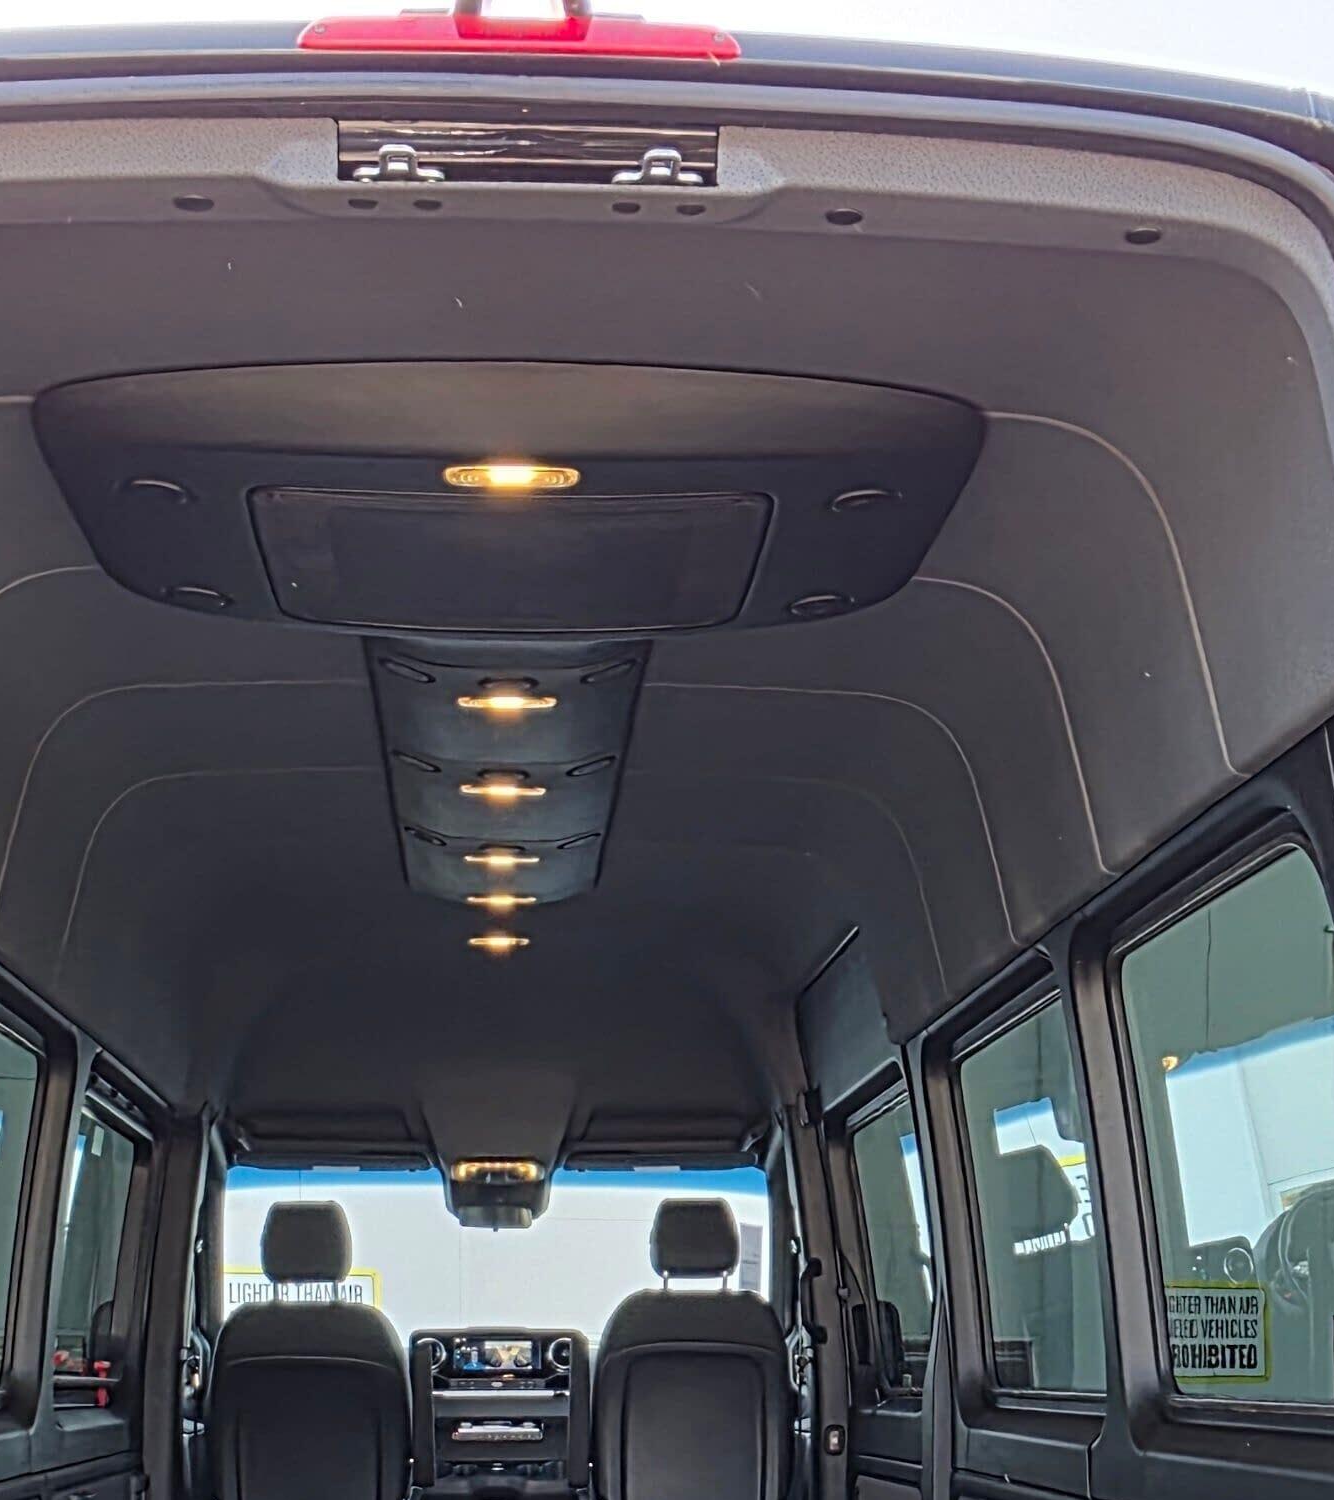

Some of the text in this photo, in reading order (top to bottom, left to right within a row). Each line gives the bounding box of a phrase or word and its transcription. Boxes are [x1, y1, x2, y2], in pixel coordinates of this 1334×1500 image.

[229, 1282, 288, 1303] LIGHTR
[340, 1285, 363, 1304] AIR
[1169, 1295, 1201, 1315] GHTER
[1204, 1295, 1236, 1315] THAN
[1171, 1318, 1258, 1339] ELED VEHICLES
[1172, 1343, 1258, 1370] ROHIBITED
